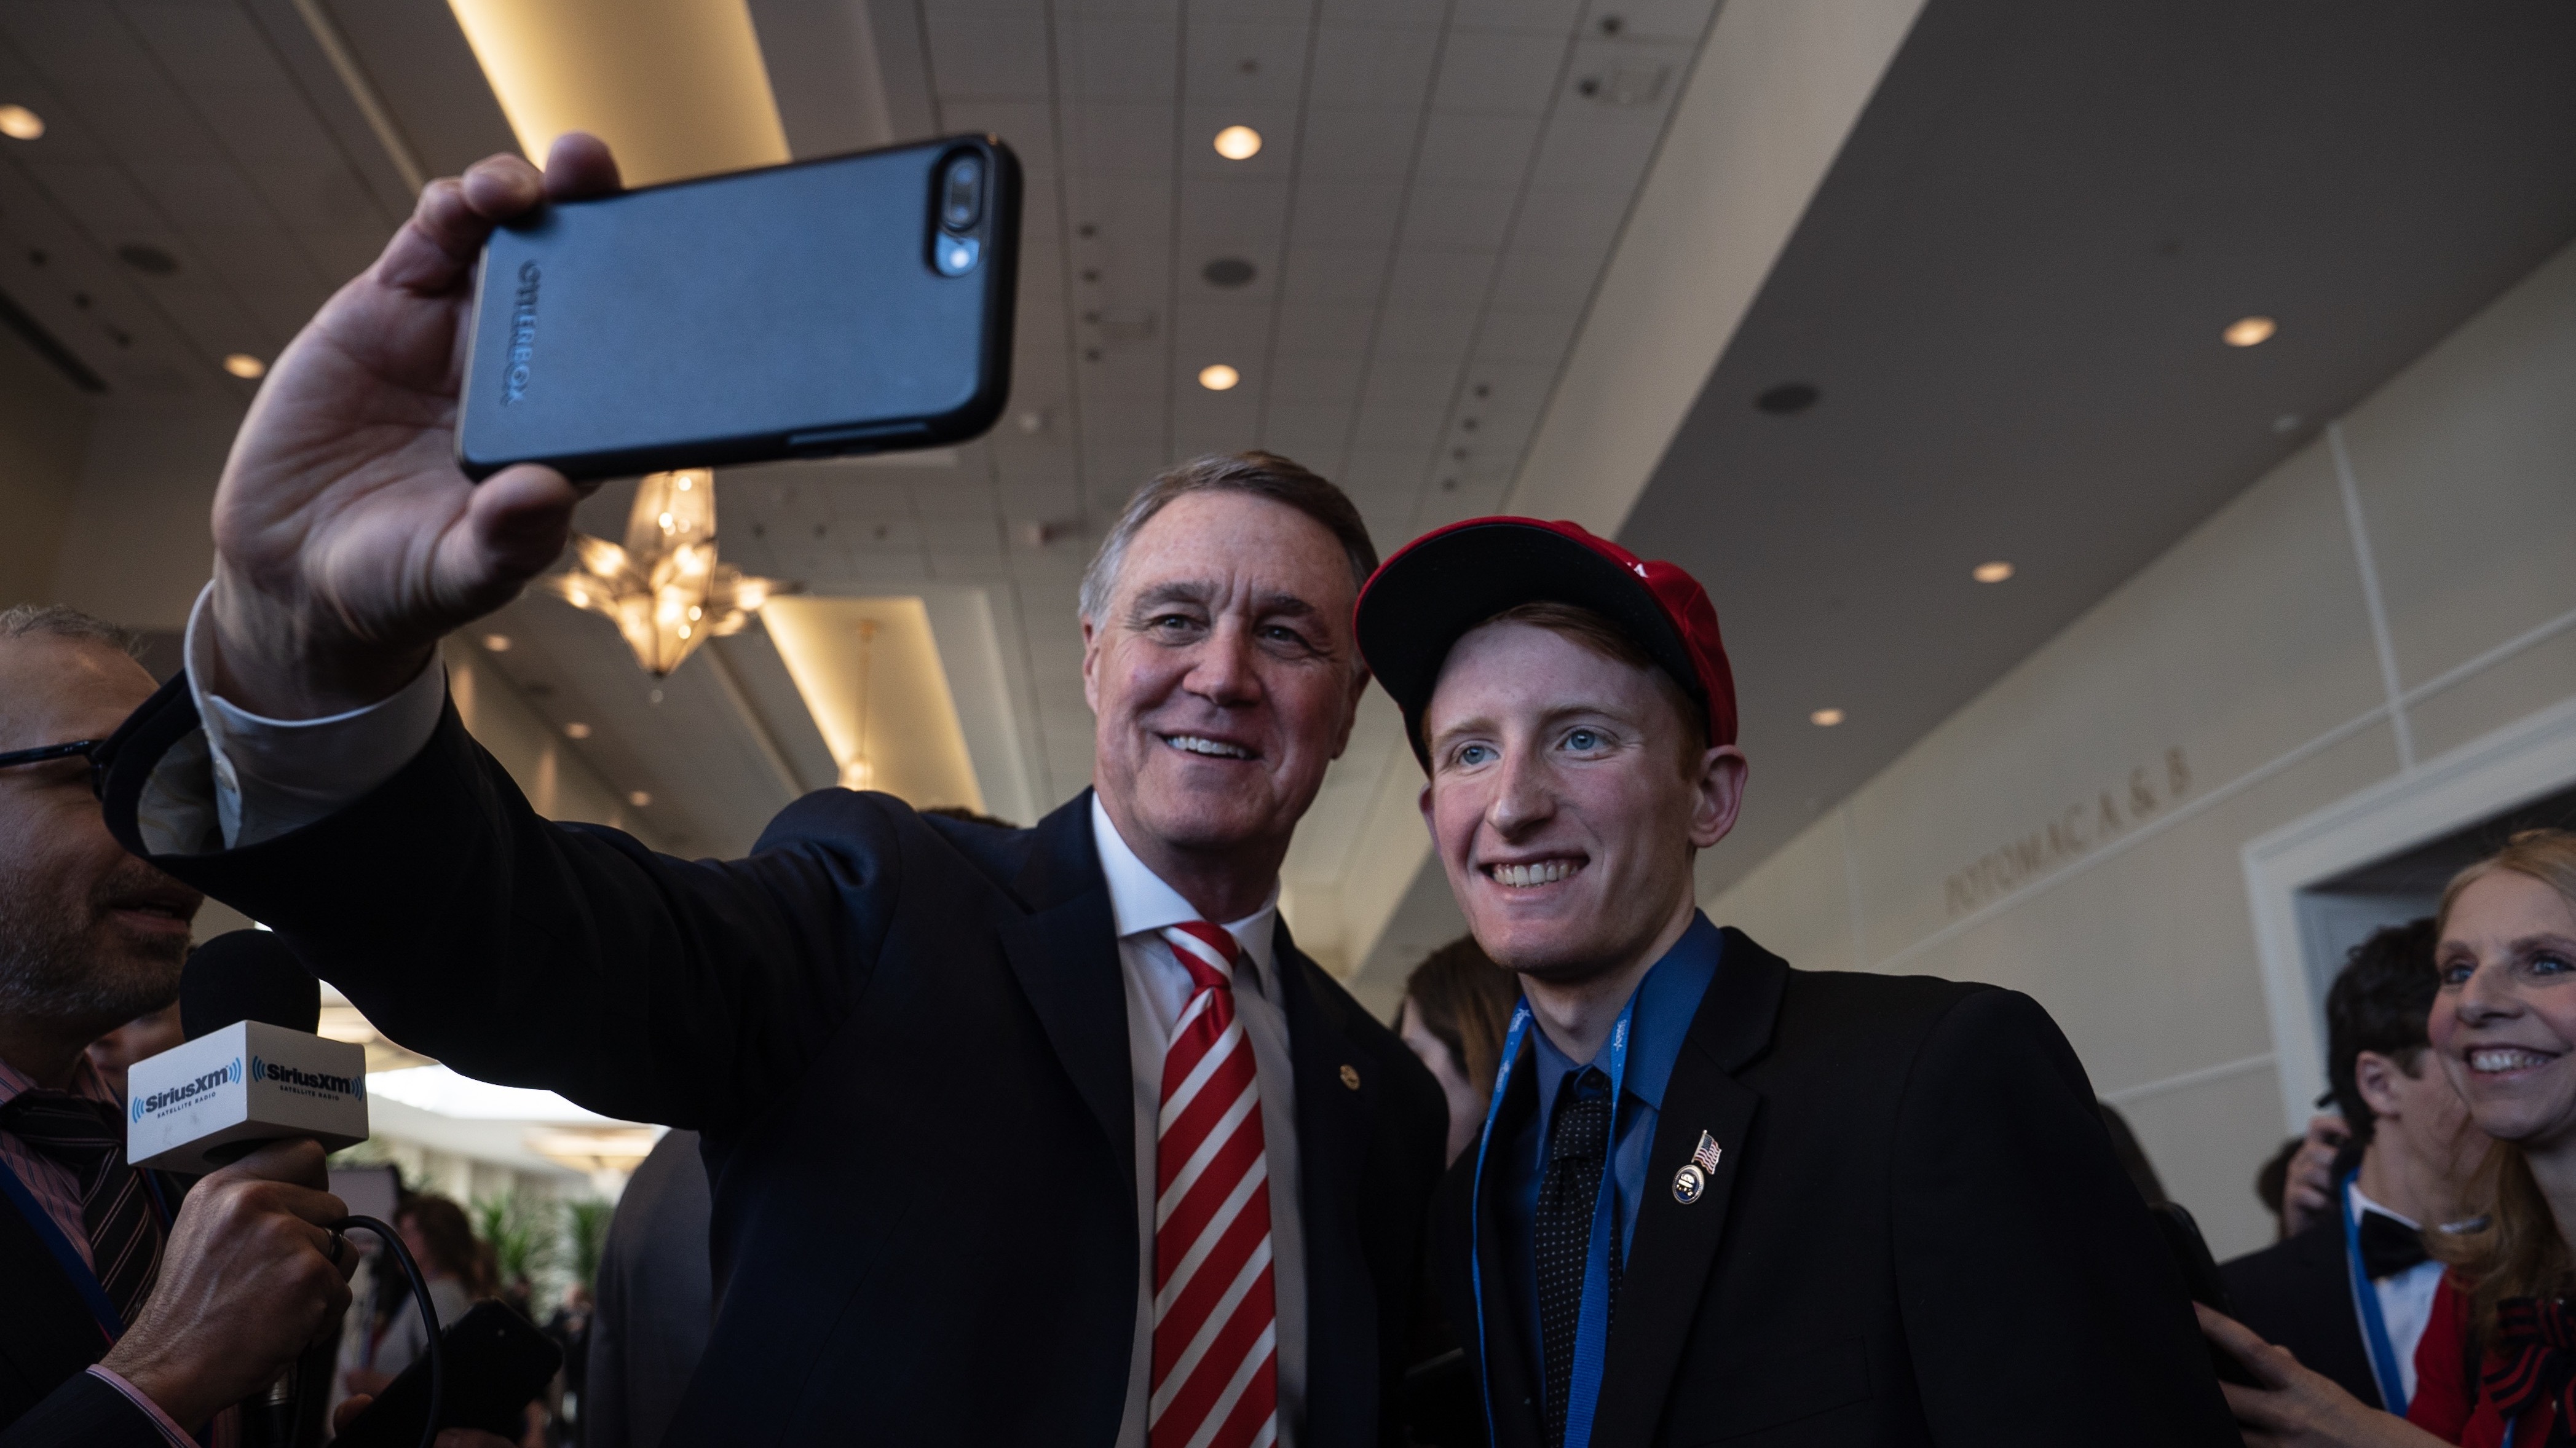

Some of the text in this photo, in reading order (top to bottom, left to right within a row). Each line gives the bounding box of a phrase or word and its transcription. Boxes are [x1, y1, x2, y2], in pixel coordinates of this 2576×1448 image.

[2097, 790, 2122, 838] A
[2163, 745, 2193, 797] B
[157, 1092, 216, 1119] SATELLITE RADIO
[280, 1085, 339, 1101] SATELLITE RADIO
